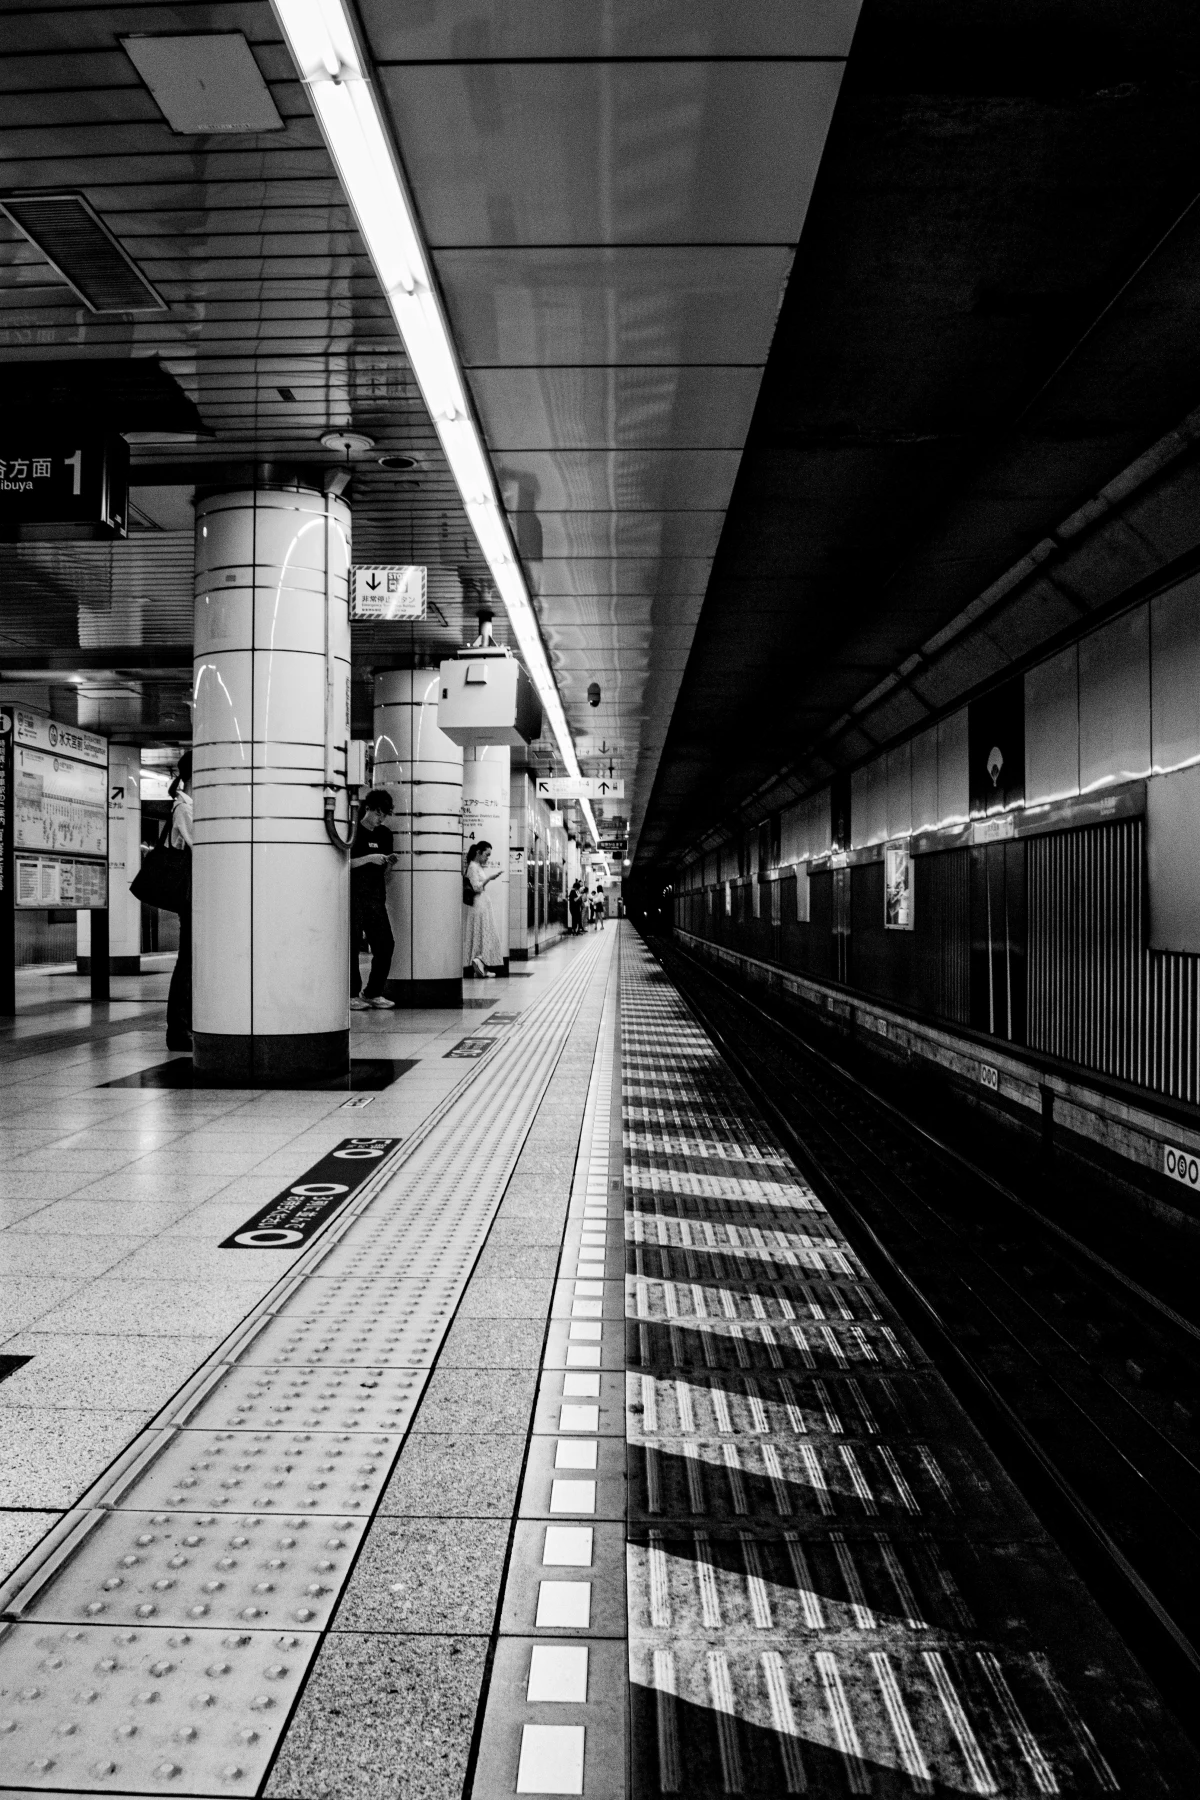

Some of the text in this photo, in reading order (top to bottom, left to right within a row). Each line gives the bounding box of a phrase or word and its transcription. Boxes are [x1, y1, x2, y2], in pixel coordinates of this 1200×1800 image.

[64, 450, 81, 495] 1
[361, 595, 416, 604] 非常停止タン
